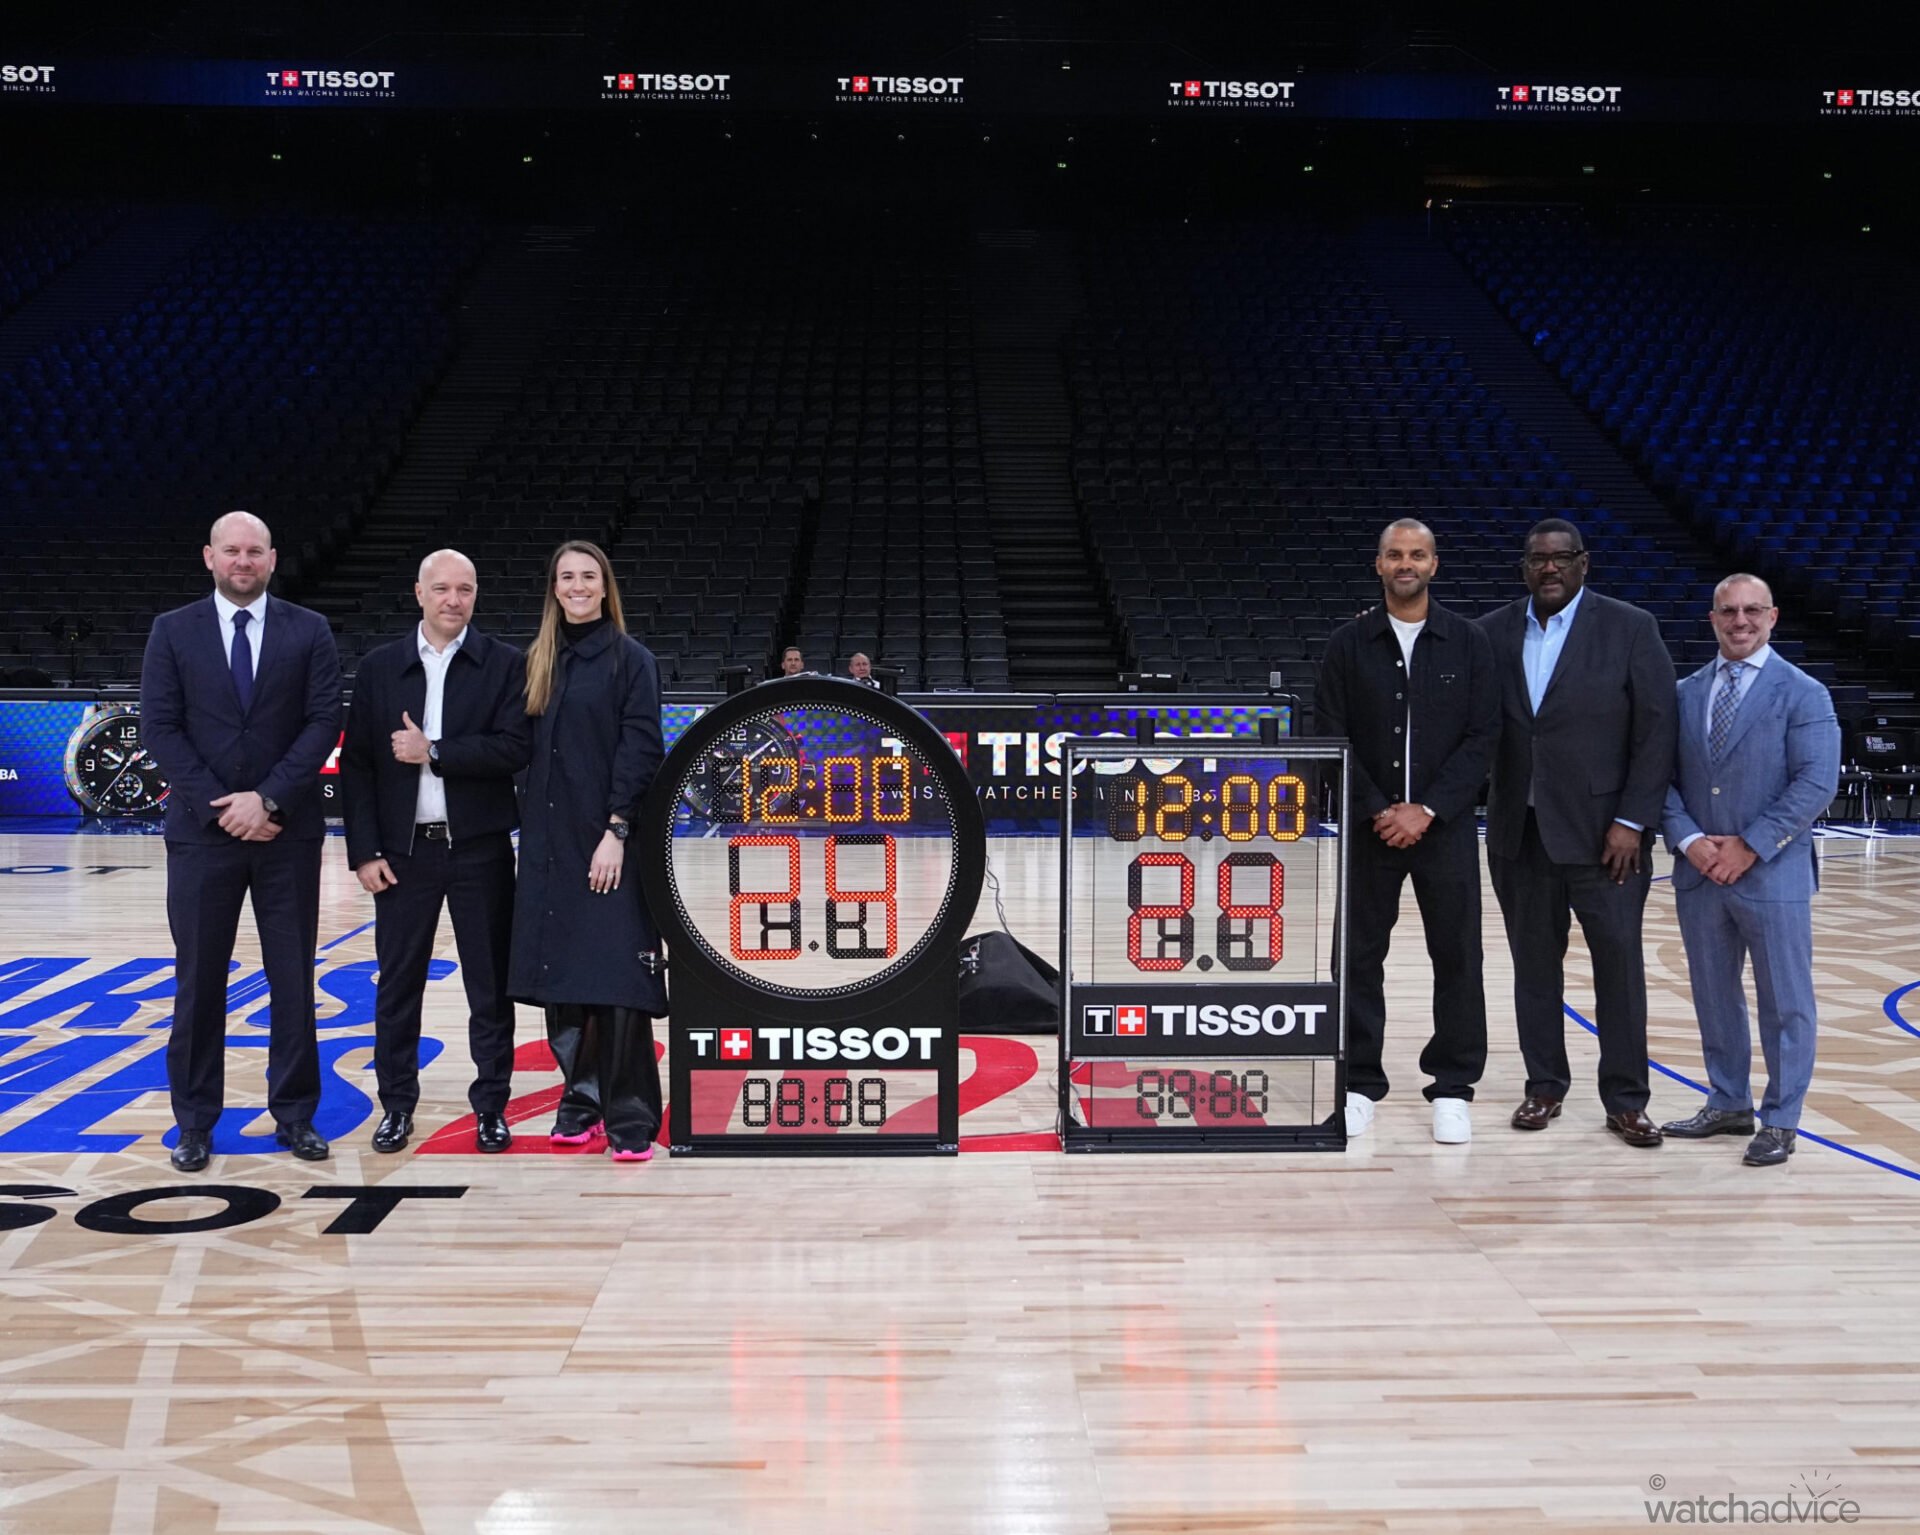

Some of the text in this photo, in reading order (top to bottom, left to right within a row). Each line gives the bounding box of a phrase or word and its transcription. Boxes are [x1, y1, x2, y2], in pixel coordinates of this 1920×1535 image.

[301, 71, 395, 88] TISSOT
[637, 74, 730, 91] TISSOT
[872, 76, 964, 94] TISSOT
[1204, 81, 1295, 98] TISSOT
[1531, 86, 1622, 103] TISSOT
[119, 726, 137, 739] 12
[740, 756, 910, 822] 12:00
[975, 785, 1078, 799] ATCHES
[1136, 775, 1306, 841] 12:00
[728, 835, 897, 960] 24
[1127, 852, 1284, 971] 24
[1151, 1004, 1327, 1036] TISSOT
[758, 1027, 942, 1060] TISSOT
